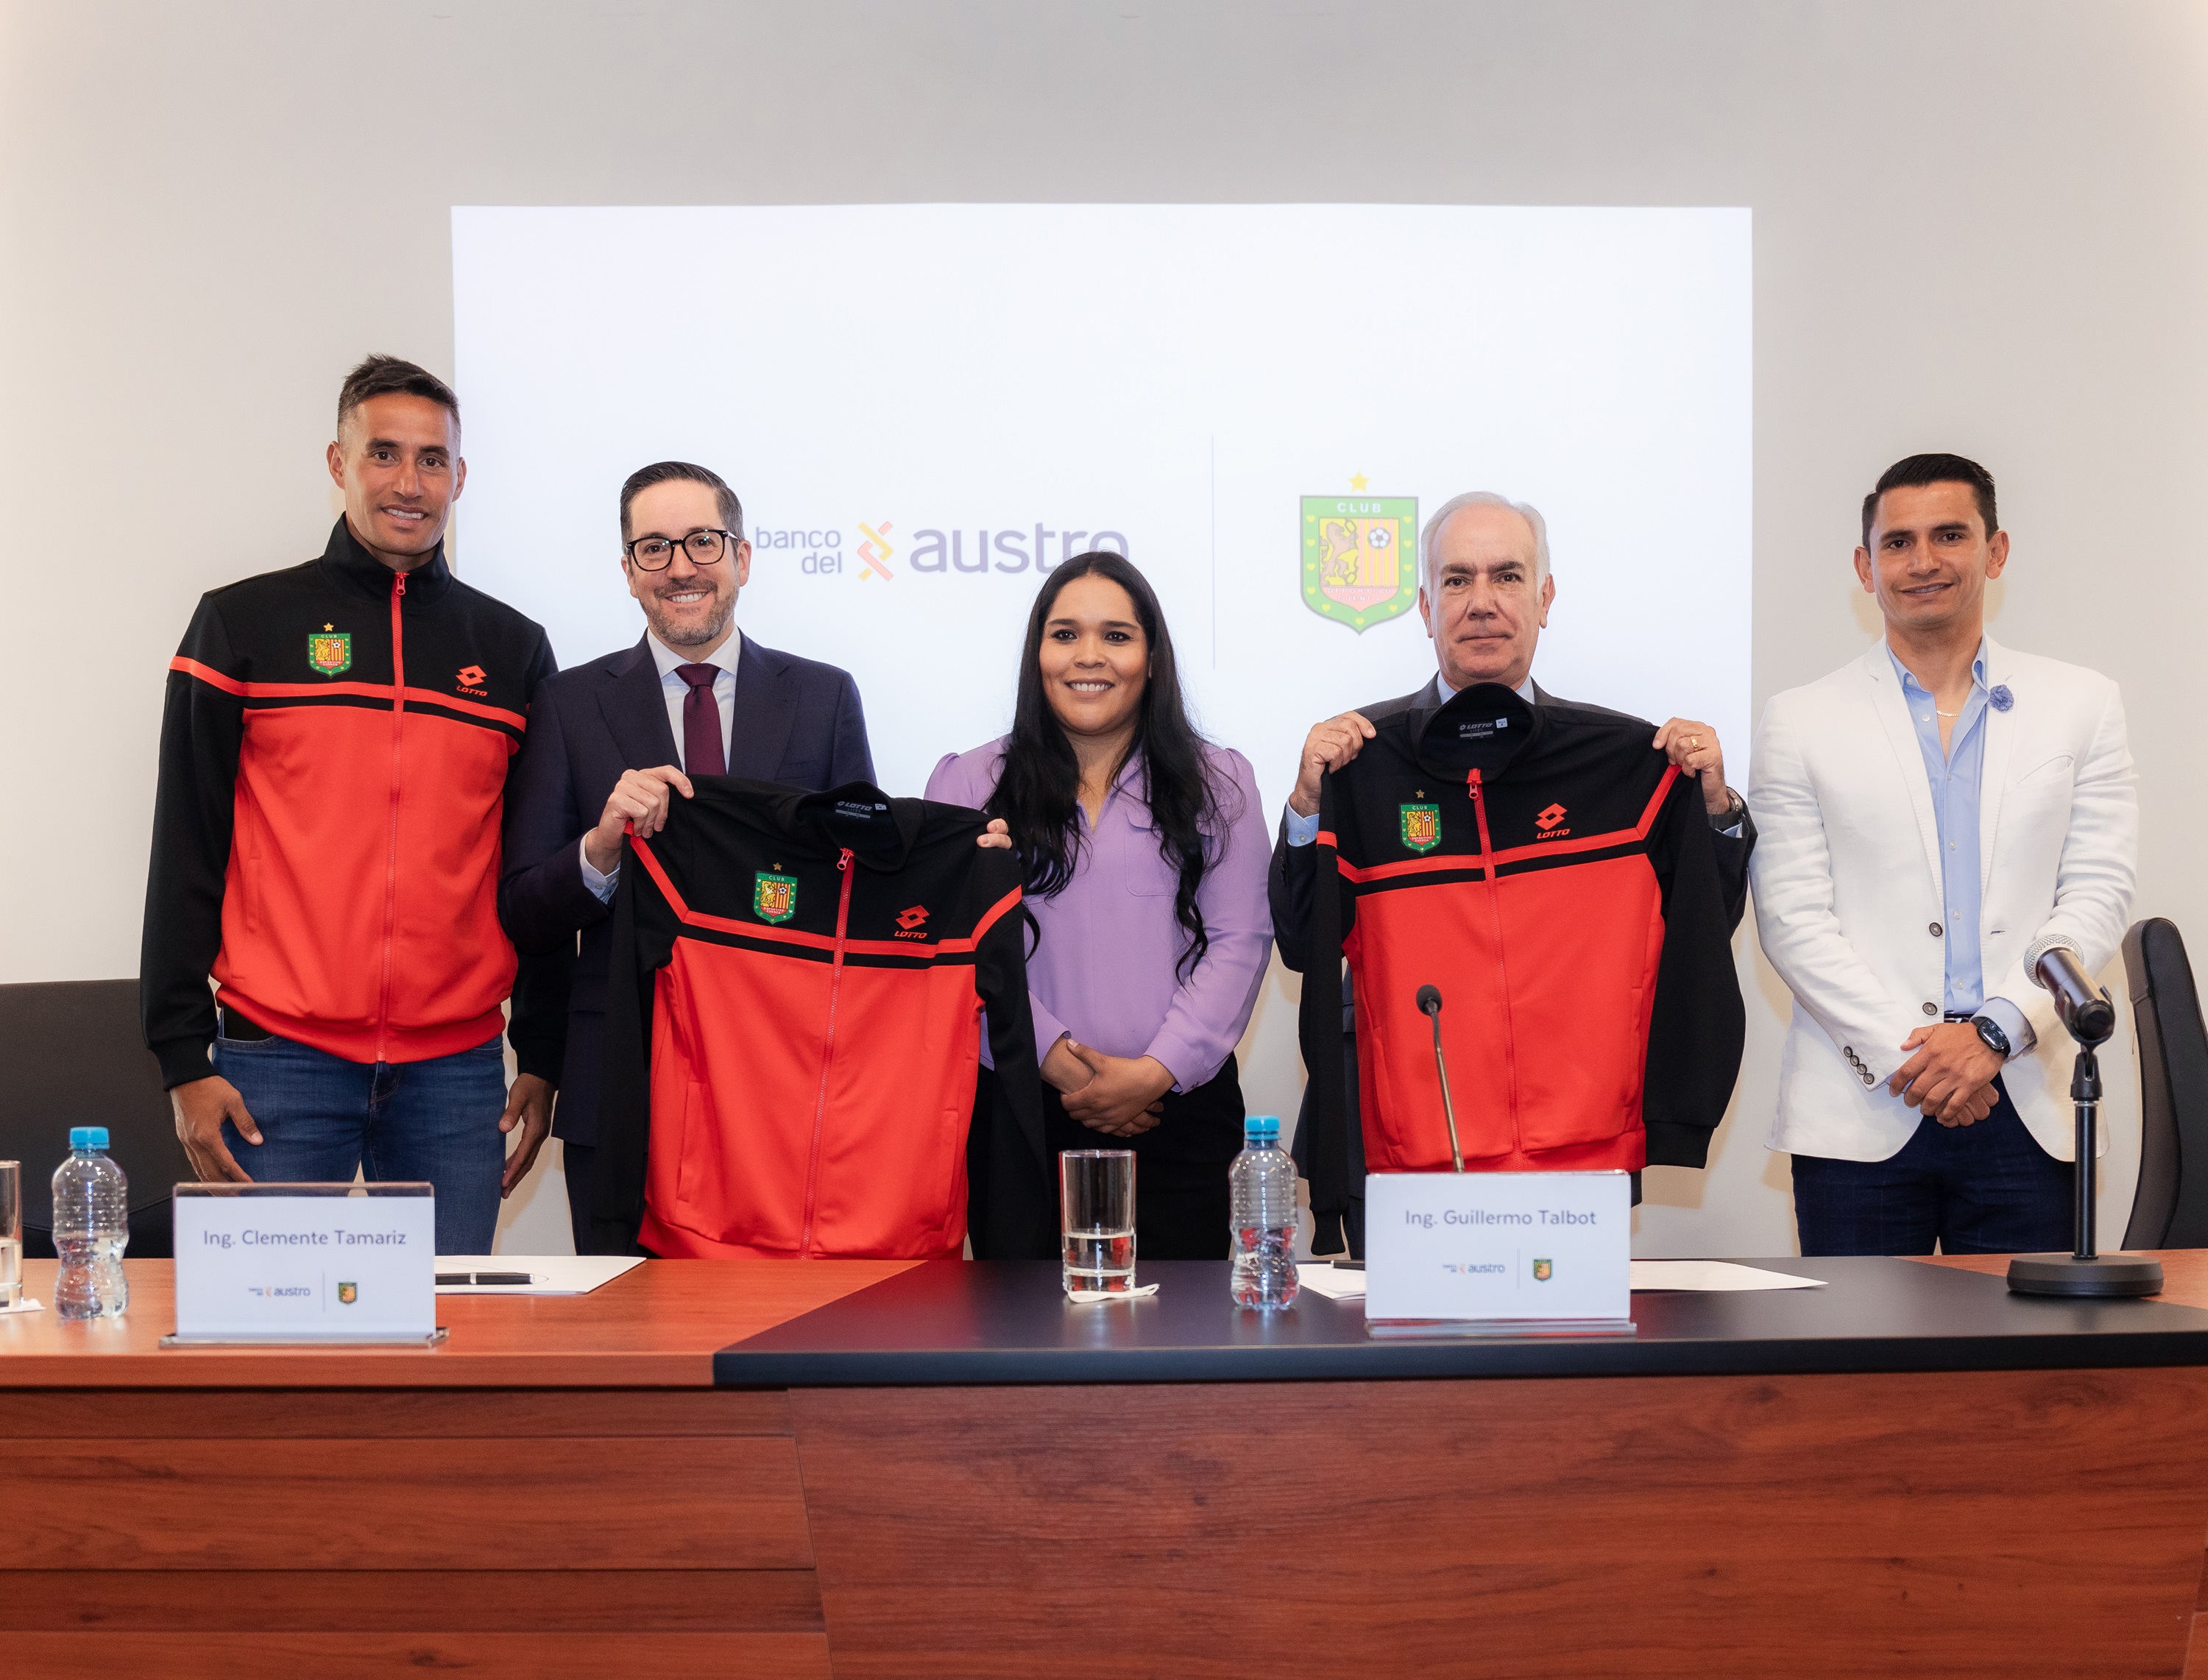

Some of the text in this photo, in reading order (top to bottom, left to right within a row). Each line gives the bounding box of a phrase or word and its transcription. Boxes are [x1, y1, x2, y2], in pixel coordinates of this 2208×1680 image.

[1337, 502, 1381, 513] CLUB
[755, 526, 841, 549] banco
[801, 550, 842, 574] del
[456, 685, 487, 697] LOTTO
[845, 802, 872, 811] LOTTO
[1537, 829, 1570, 839] LOTTO
[894, 930, 927, 939] LOTTO
[1406, 1210, 1597, 1228] Ing. Guillermo Talbot
[204, 1230, 406, 1248] Ing. Clemente Tamariz
[1468, 1263, 1506, 1273] austro
[273, 1286, 311, 1296] austro
